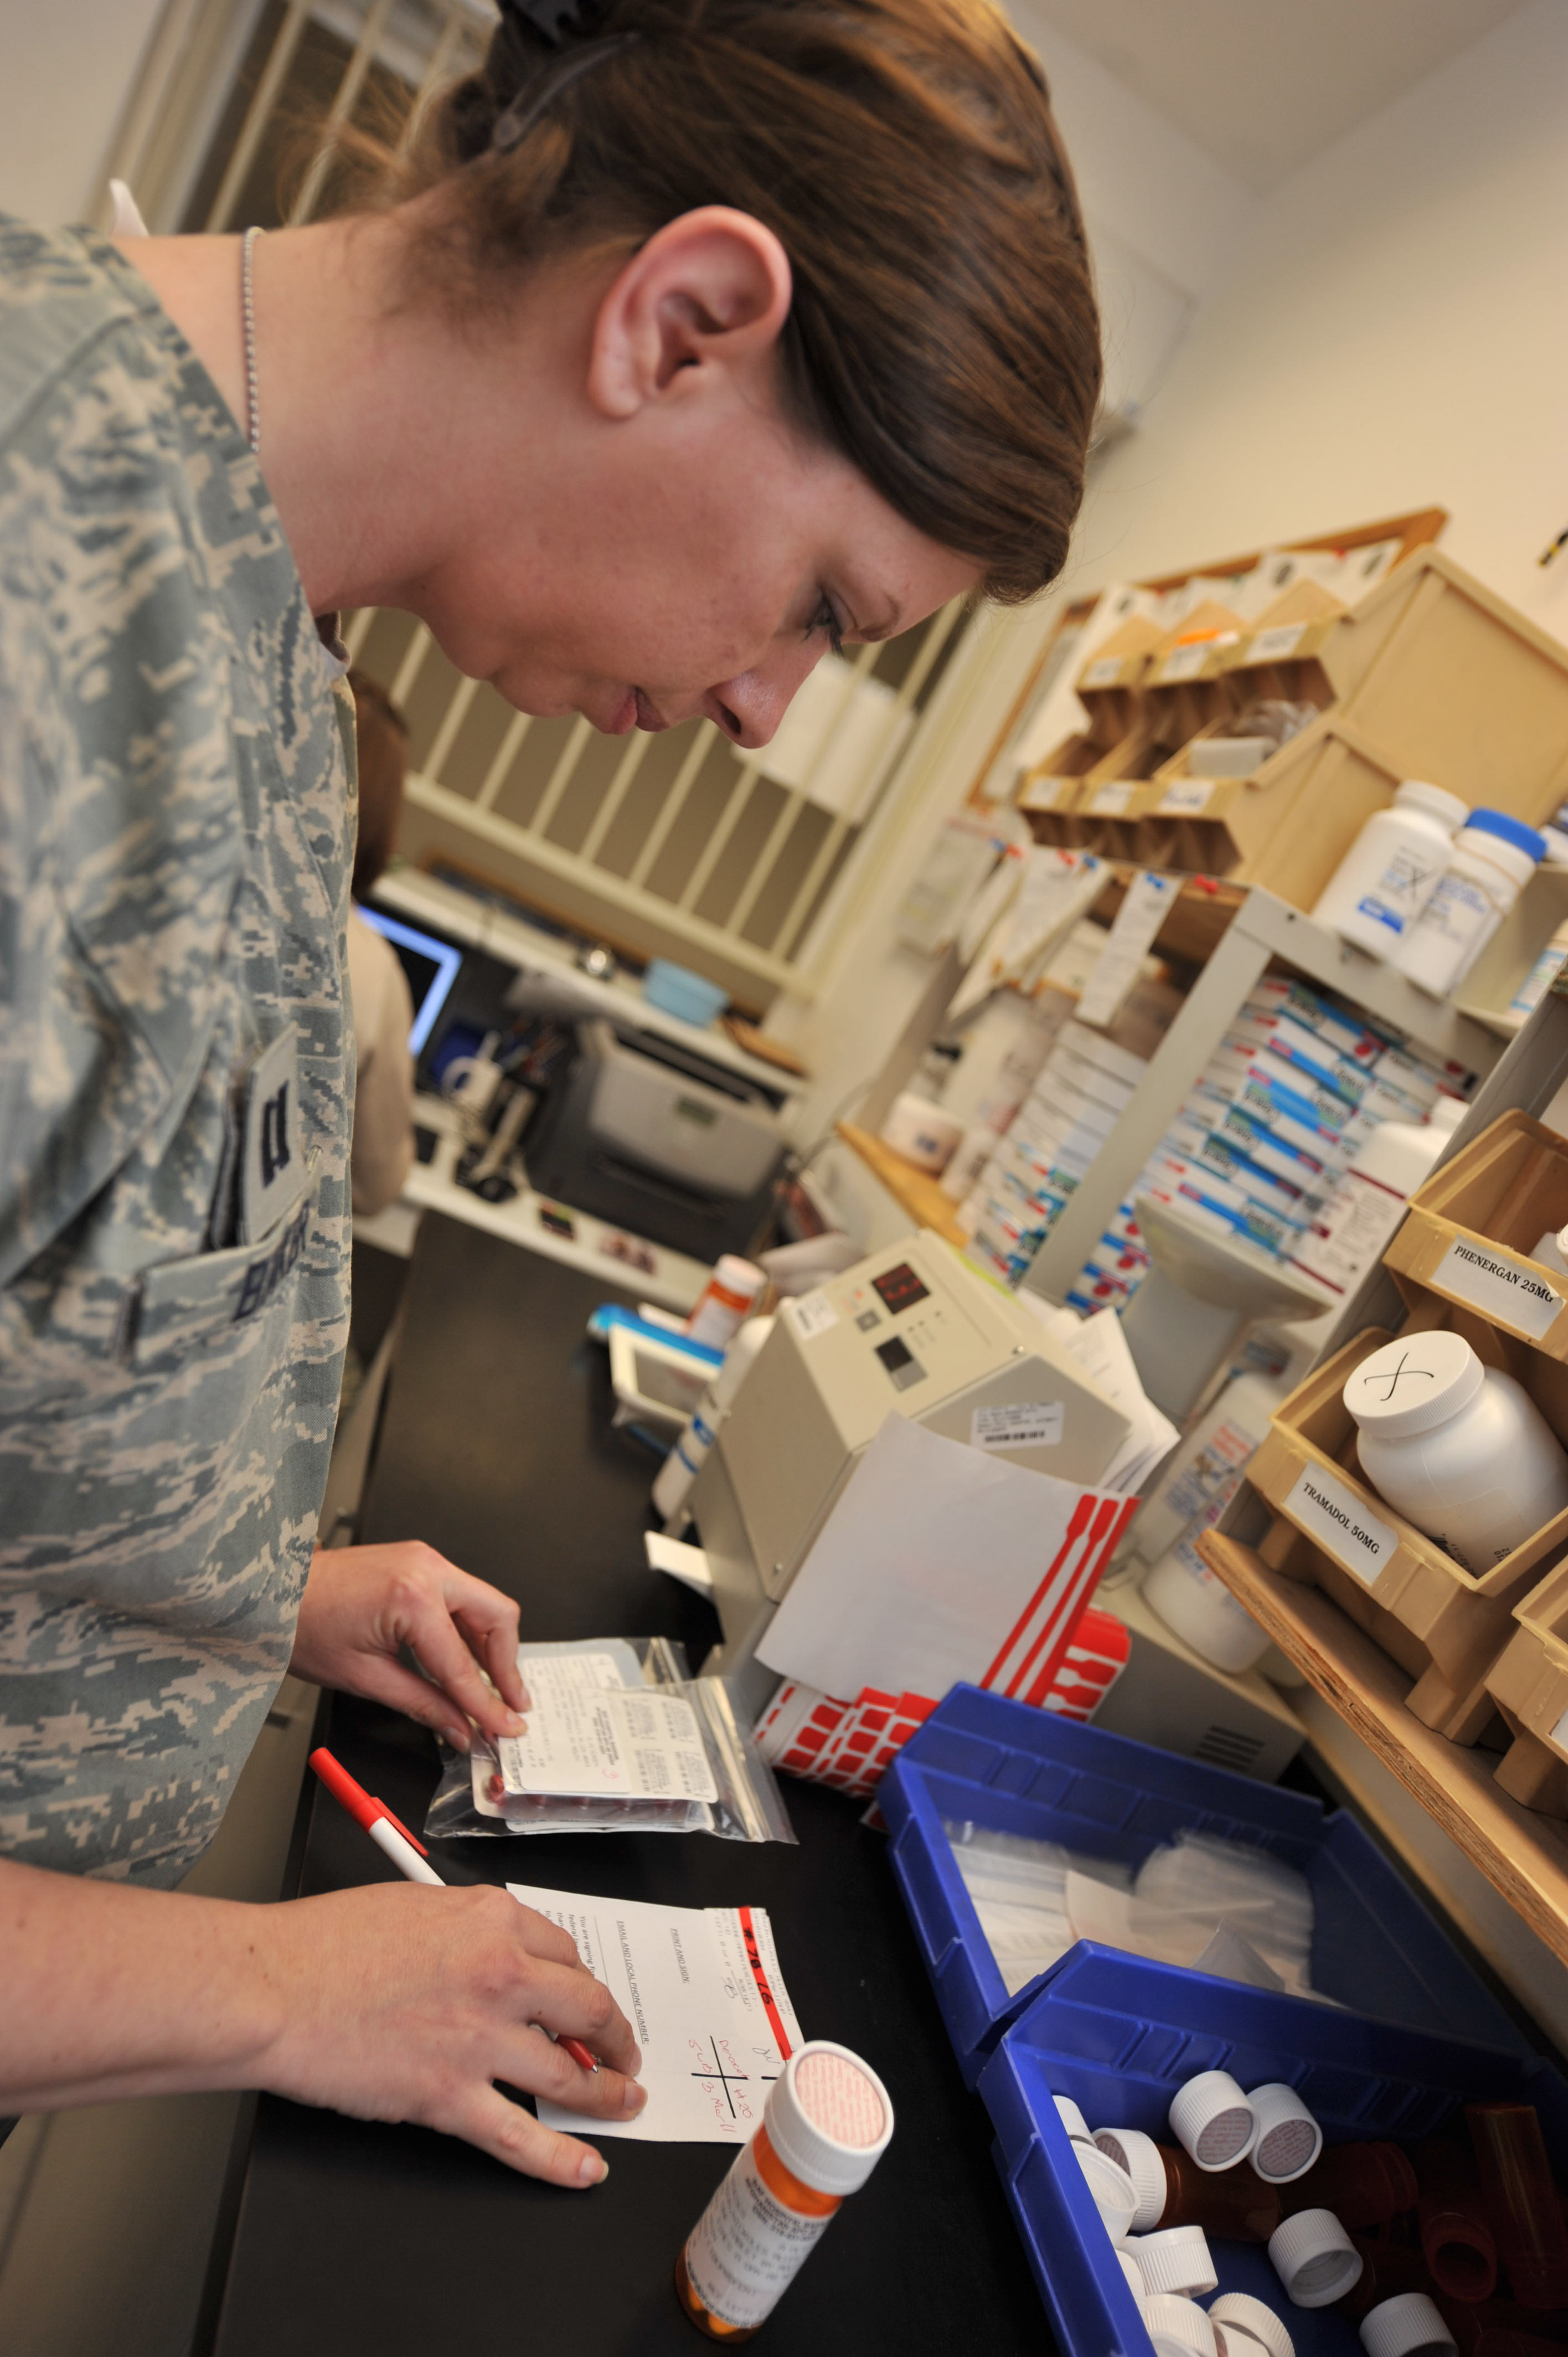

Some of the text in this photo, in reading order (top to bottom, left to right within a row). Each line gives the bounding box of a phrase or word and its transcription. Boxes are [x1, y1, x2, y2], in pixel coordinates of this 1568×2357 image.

[1454, 1246, 1520, 1284] PHENERGAN
[1304, 1483, 1379, 1554] TRAMADOL 50MG
[544, 1910, 552, 1918] to
[556, 1911, 565, 1927] than
[568, 1913, 577, 1937] federal
[579, 1916, 587, 1928] You
[582, 1940, 594, 1965] signing
[670, 1928, 690, 1983] PRINT AND SIGN:
[616, 1921, 650, 2044] EMAIL AND LOCAL PHONE NUMBER:
